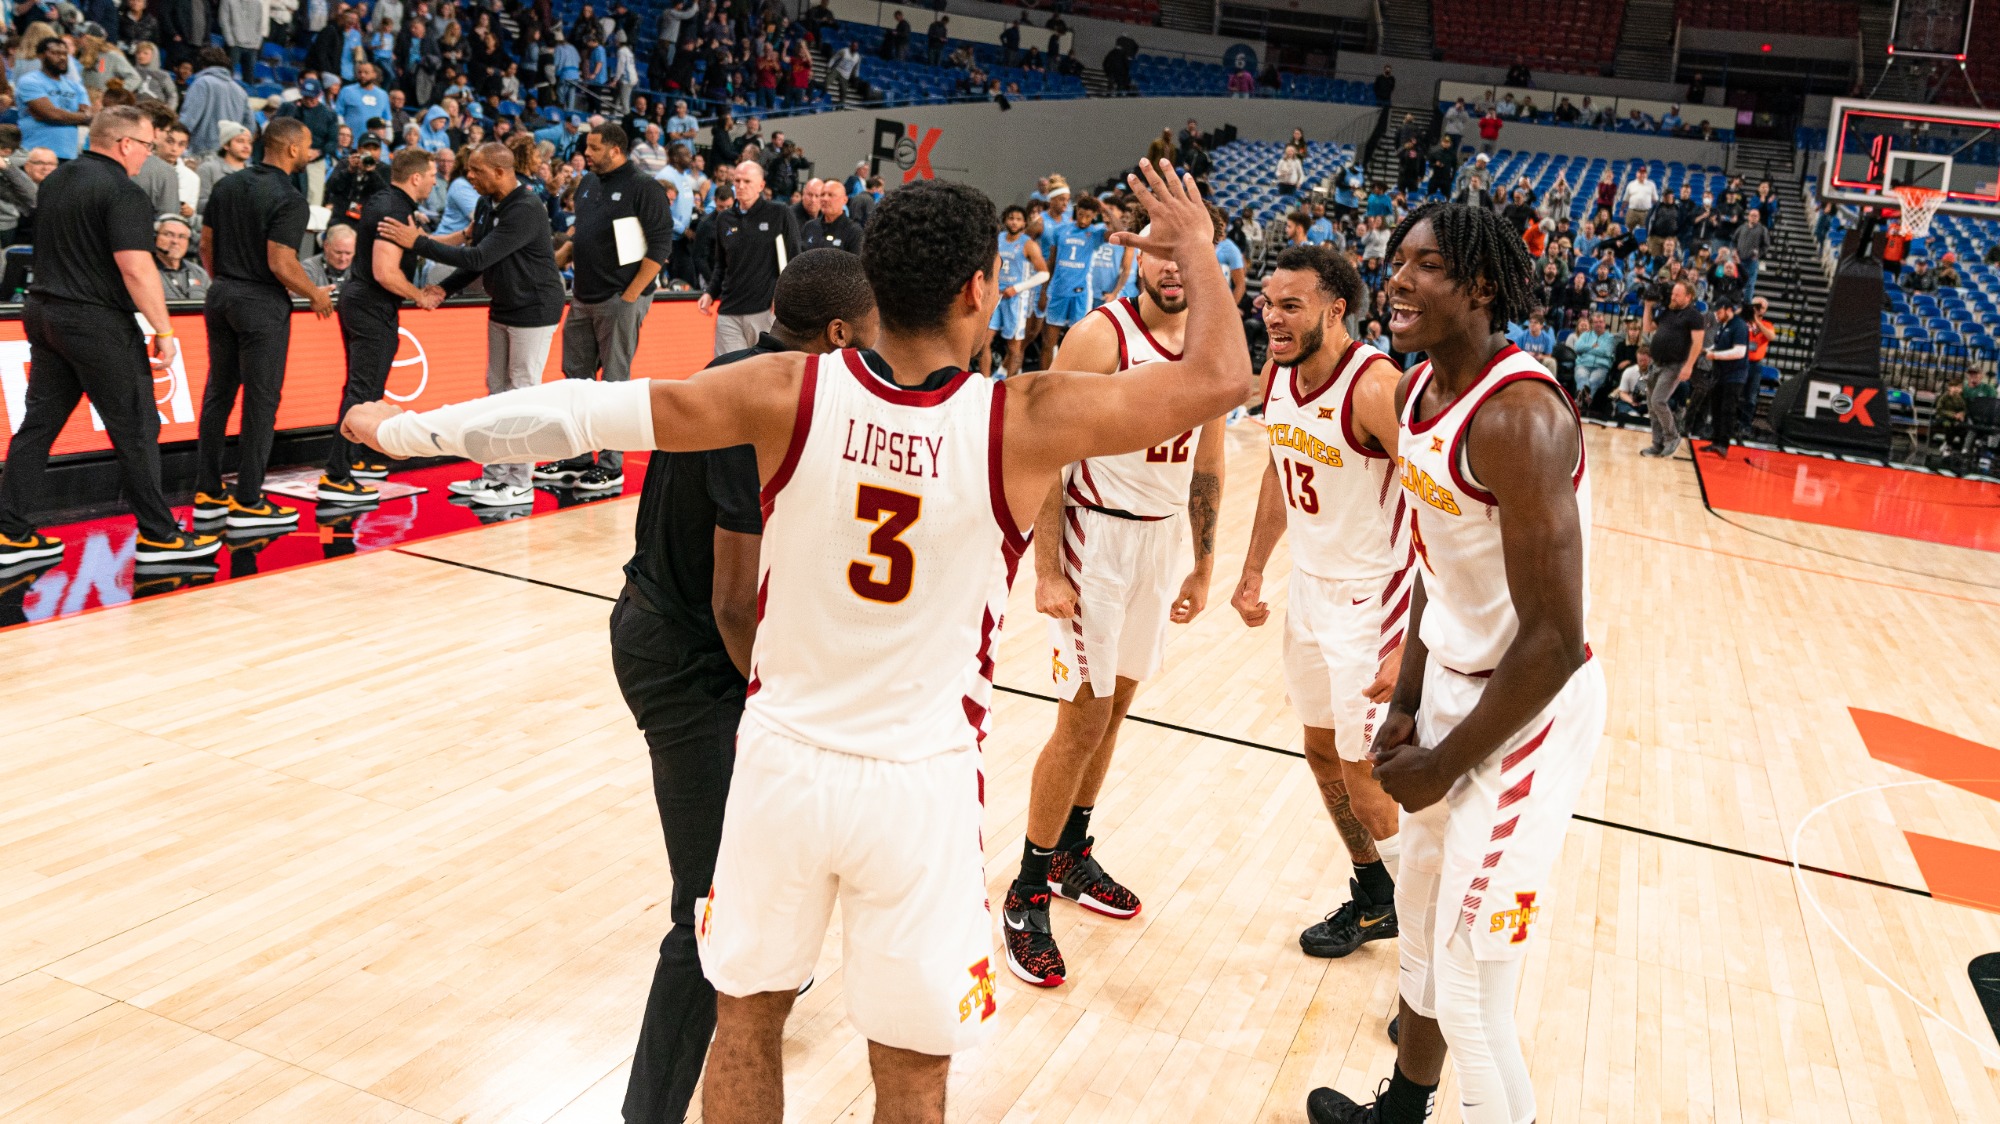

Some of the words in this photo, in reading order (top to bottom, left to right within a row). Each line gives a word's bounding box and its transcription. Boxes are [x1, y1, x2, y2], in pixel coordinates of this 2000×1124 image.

[1235, 53, 1246, 69] 6
[1069, 245, 1077, 260] 1
[843, 419, 943, 478] LIPSEY
[1266, 423, 1344, 468] YCLONES
[1283, 457, 1321, 515] 13
[846, 482, 923, 606] 3
